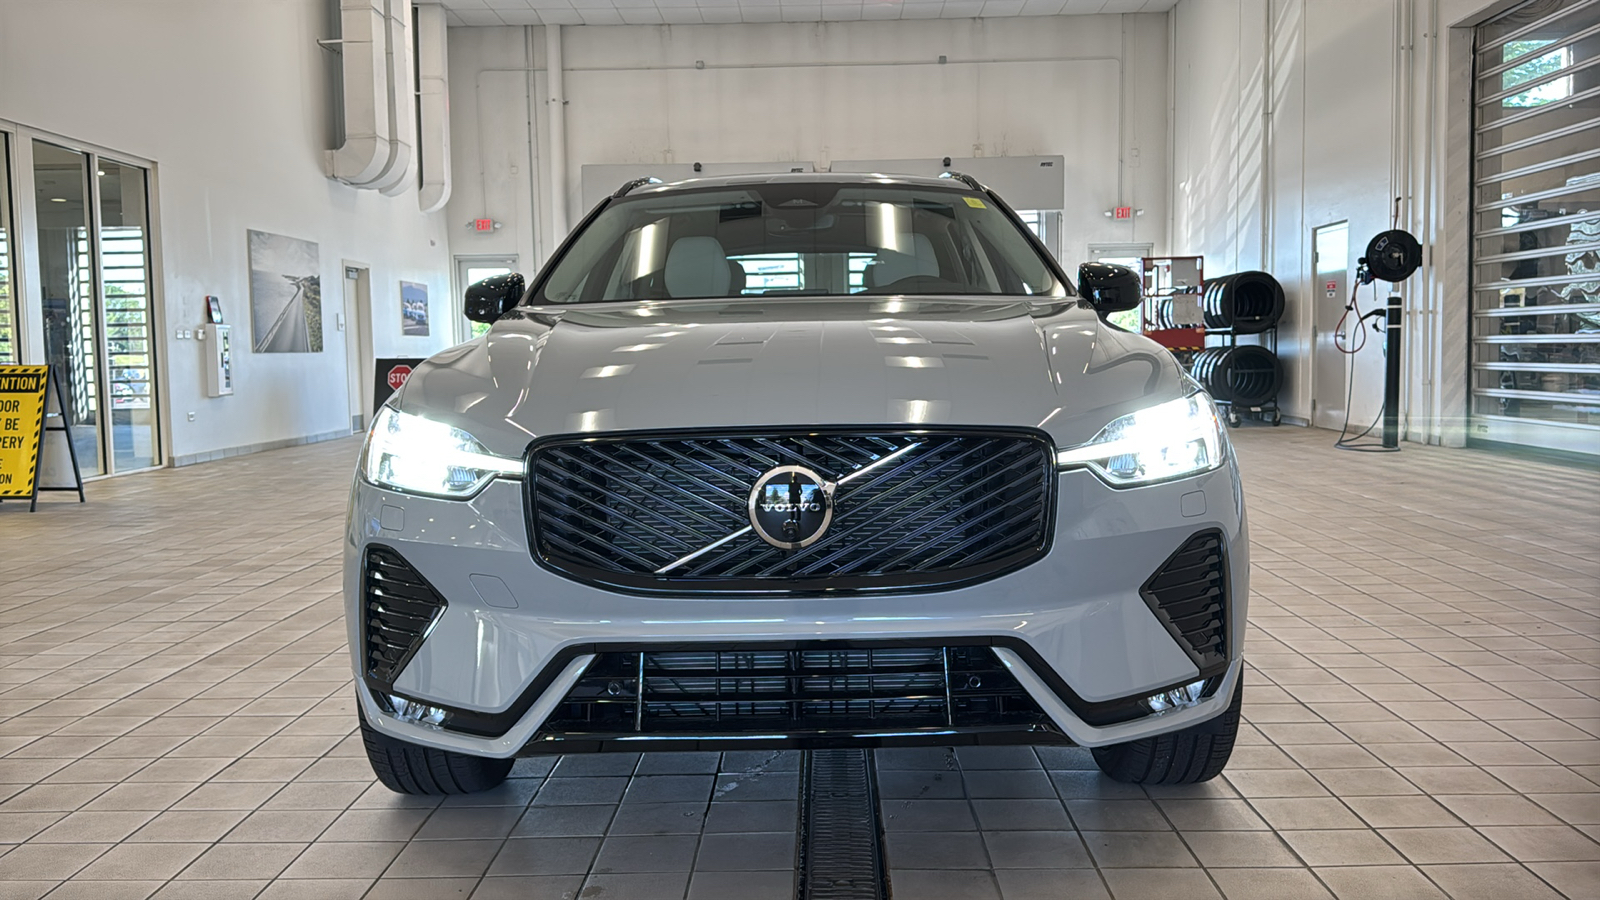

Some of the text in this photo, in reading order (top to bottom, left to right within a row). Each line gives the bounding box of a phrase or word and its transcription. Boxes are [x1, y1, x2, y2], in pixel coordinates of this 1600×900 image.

[1116, 207, 1130, 218] EXIT
[476, 219, 490, 230] EXIT
[389, 372, 408, 383] STO
[4, 418, 20, 431] BE
[760, 503, 821, 512] VOLVO
